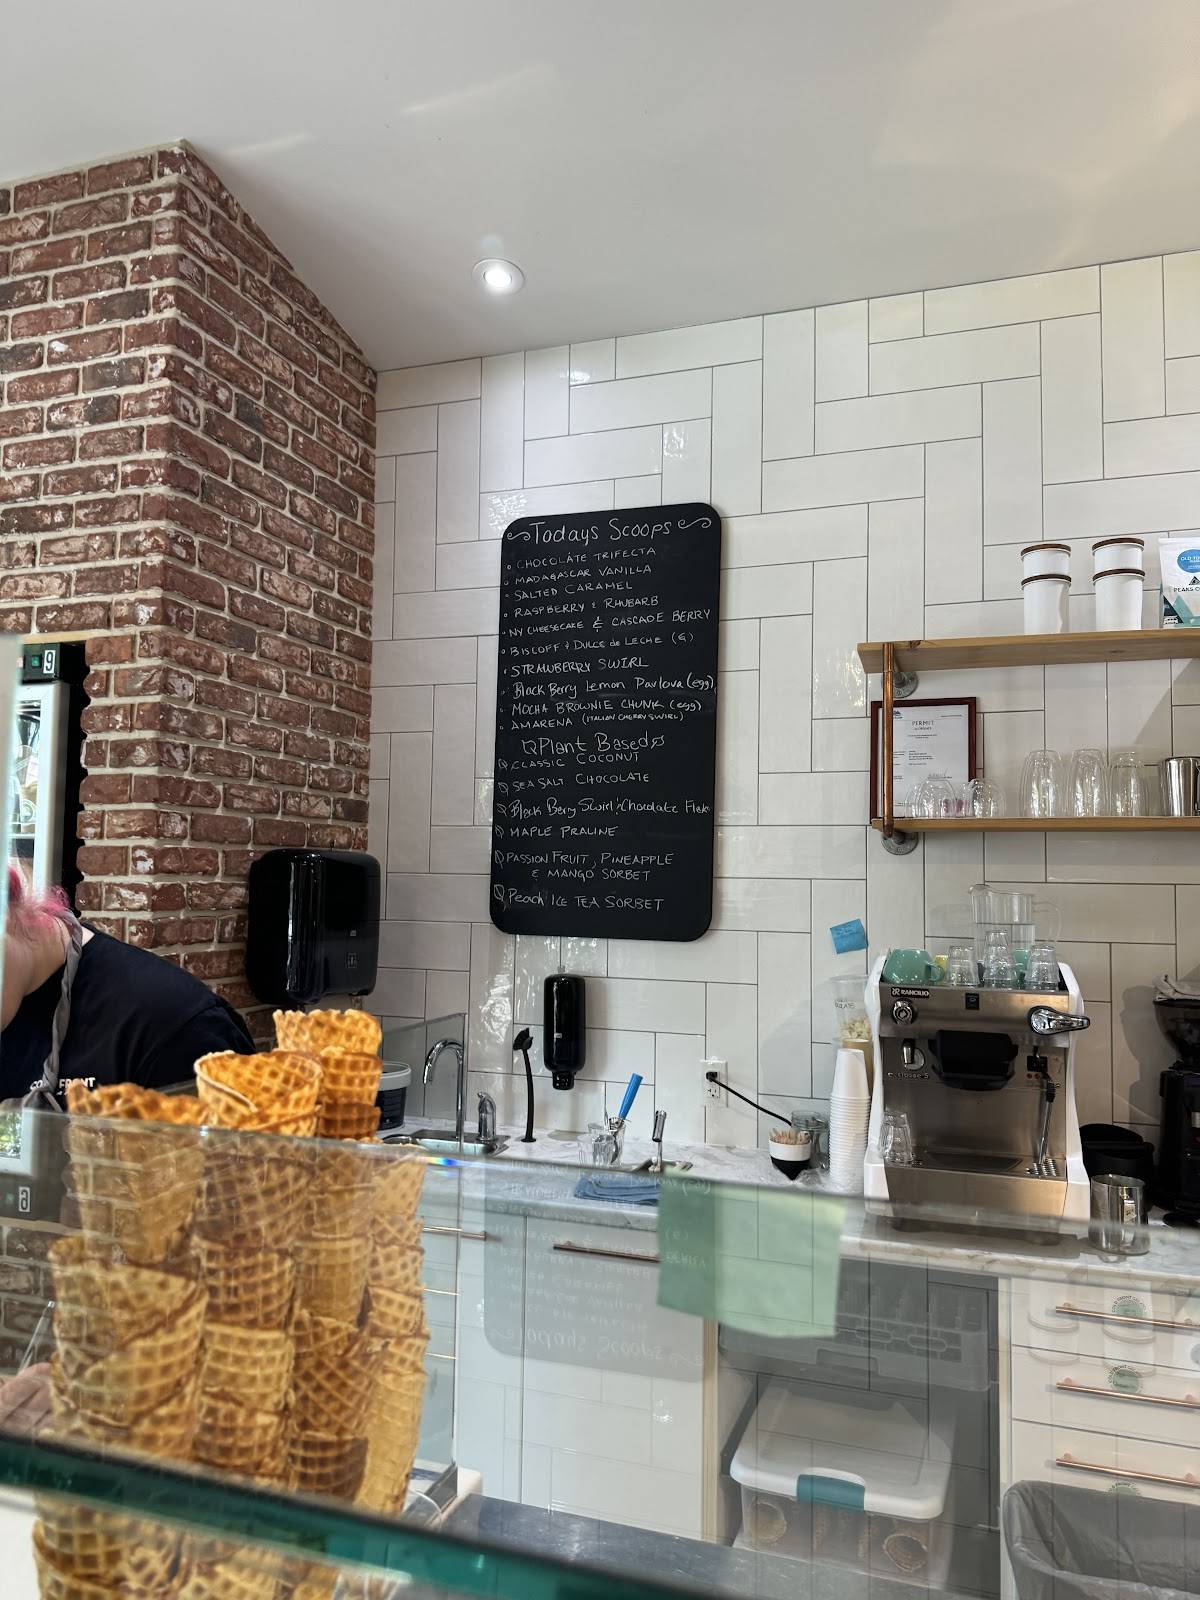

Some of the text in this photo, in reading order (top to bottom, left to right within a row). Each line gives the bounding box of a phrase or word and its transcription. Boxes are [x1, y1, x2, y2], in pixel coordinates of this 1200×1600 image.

[529, 517, 672, 546] Todays Scoops
[516, 547, 657, 570] CHOCOLATE TRIFECTA
[514, 565, 652, 585] MADAGASCAR VANILLA
[514, 581, 633, 602] SALTED CARAMEL
[514, 600, 584, 618] RASPBERRY
[604, 595, 659, 610] RHUBARB
[509, 608, 711, 638] NY CHEESECAKE & CASCADE BERRY
[510, 642, 560, 657] BISCOFF
[573, 638, 605, 651] DULCE
[625, 636, 663, 646] LECHE
[46, 652, 54, 672] 9
[510, 656, 650, 678] STRAWBERRY SWIRL
[586, 680, 625, 693] Lemon
[634, 676, 684, 690] Pavlova
[512, 702, 549, 717] MOCHA
[556, 699, 614, 715] BROWNIE
[621, 698, 665, 710] CHUNK
[511, 717, 573, 731] AMARENA
[538, 730, 649, 756] Plant Based
[510, 751, 640, 771] CLASSIC COCONUT
[512, 773, 650, 793] SEA SALT CHOCOLATE
[578, 798, 614, 813] Swirl
[510, 825, 619, 839] MAPLE PRALINE
[506, 852, 548, 864] PASSION
[600, 852, 674, 866] PINEAPPLE
[547, 868, 595, 883] MANGO
[602, 869, 651, 882] SORBET
[507, 888, 665, 912] Peach ICE TEA SORBET
